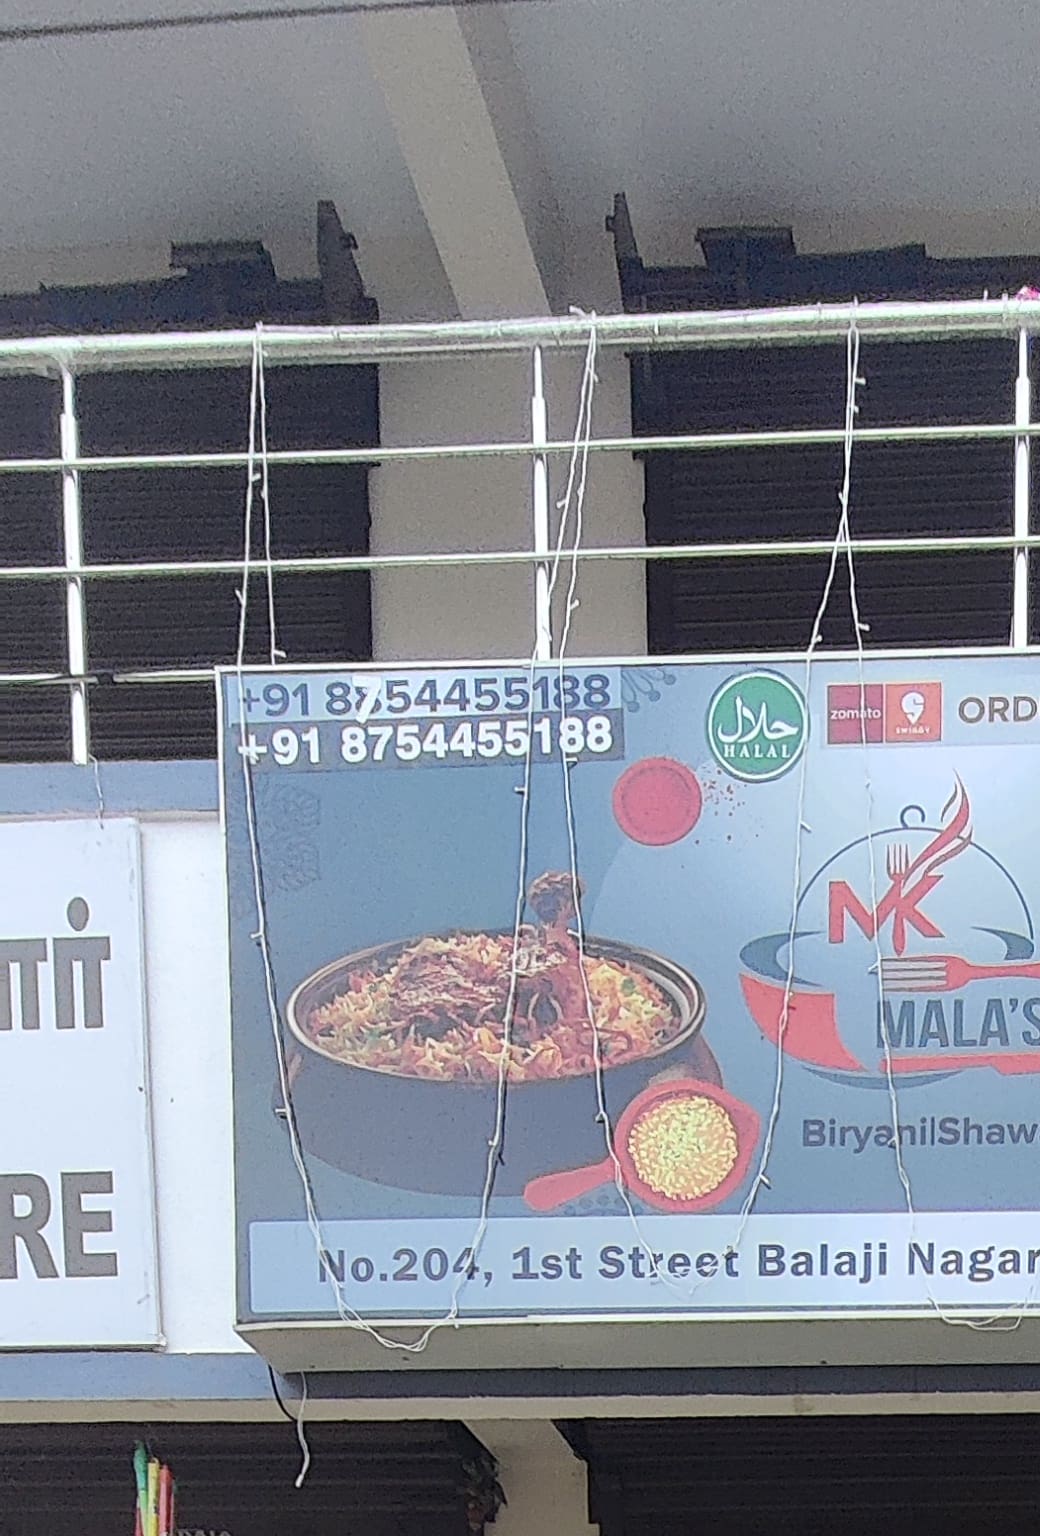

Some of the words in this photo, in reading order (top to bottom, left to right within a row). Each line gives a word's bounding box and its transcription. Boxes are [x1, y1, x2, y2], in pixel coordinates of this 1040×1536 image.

[717, 696, 799, 742] حلال
[830, 707, 882, 720] zomato
[238, 726, 320, 765] +91
[341, 716, 613, 763] 8754455188
[723, 744, 792, 758] HALAL
[318, 1247, 493, 1287] No.204,
[512, 1247, 582, 1280] 1st
[598, 1245, 739, 1279] Street
[758, 1243, 887, 1284] Balaji
